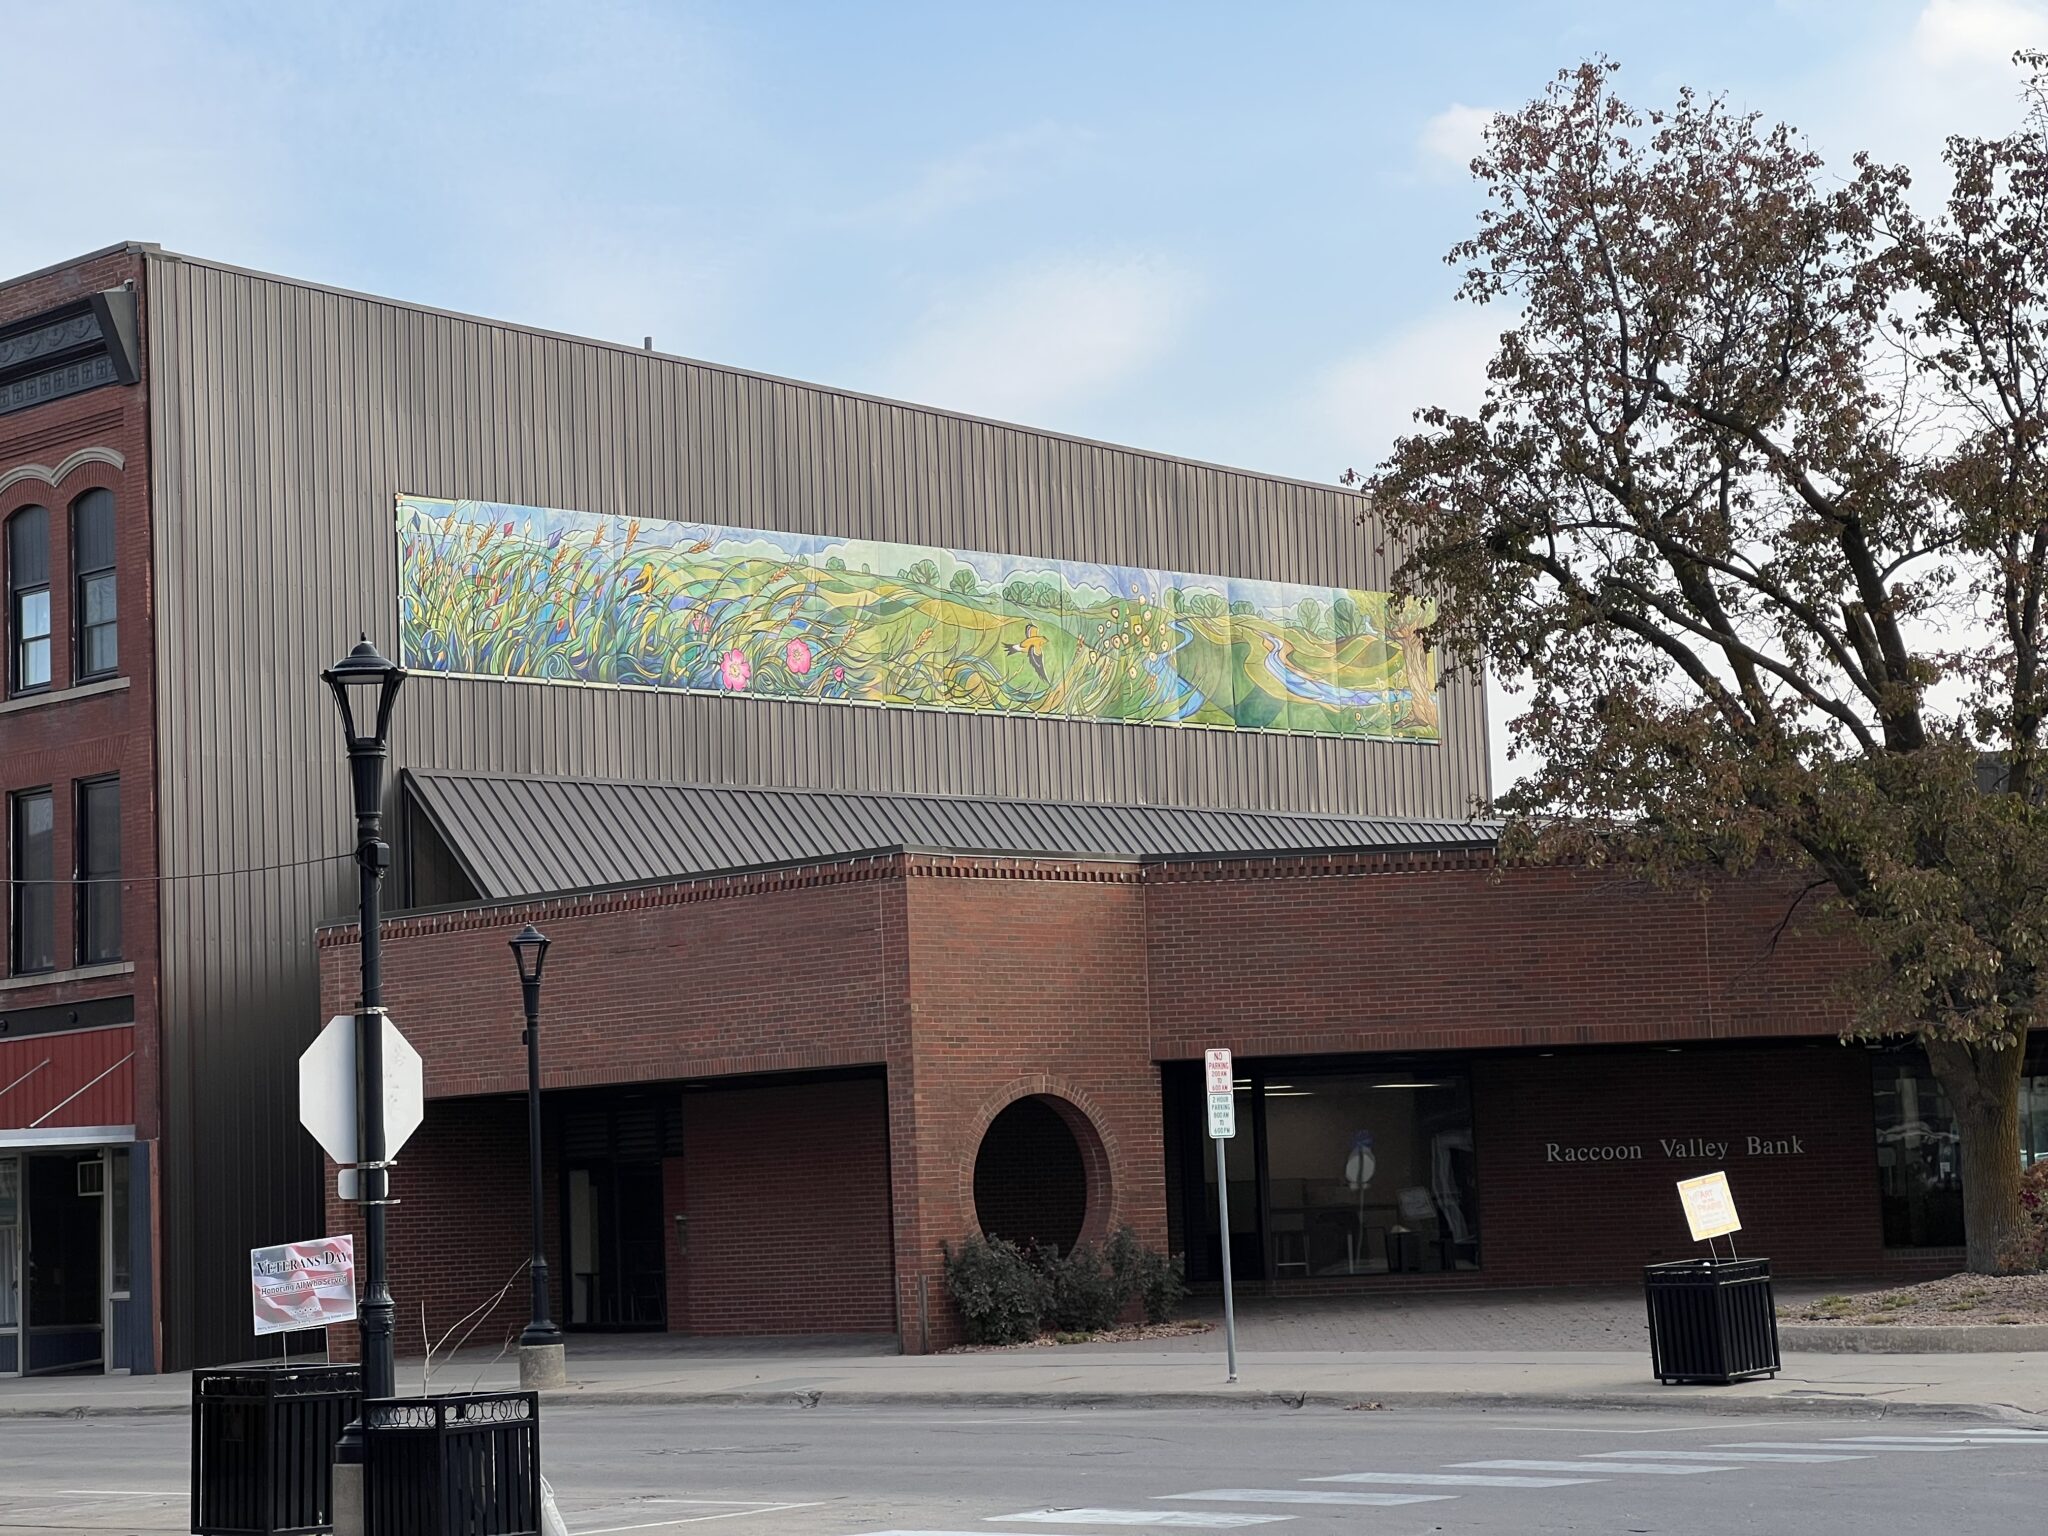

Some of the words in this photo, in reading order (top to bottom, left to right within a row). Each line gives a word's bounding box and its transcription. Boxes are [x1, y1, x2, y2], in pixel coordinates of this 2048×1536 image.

[1214, 1052, 1222, 1060] NO
[1546, 1143, 1642, 1162] Raccoon
[1659, 1138, 1729, 1160] Valley
[1747, 1135, 1805, 1155] Bank
[257, 1256, 320, 1275] VETERANS
[324, 1251, 347, 1265] DAY
[261, 1284, 294, 1295] Honoring
[295, 1282, 306, 1290] All
[306, 1280, 322, 1289] Who
[324, 1276, 347, 1286] Served
